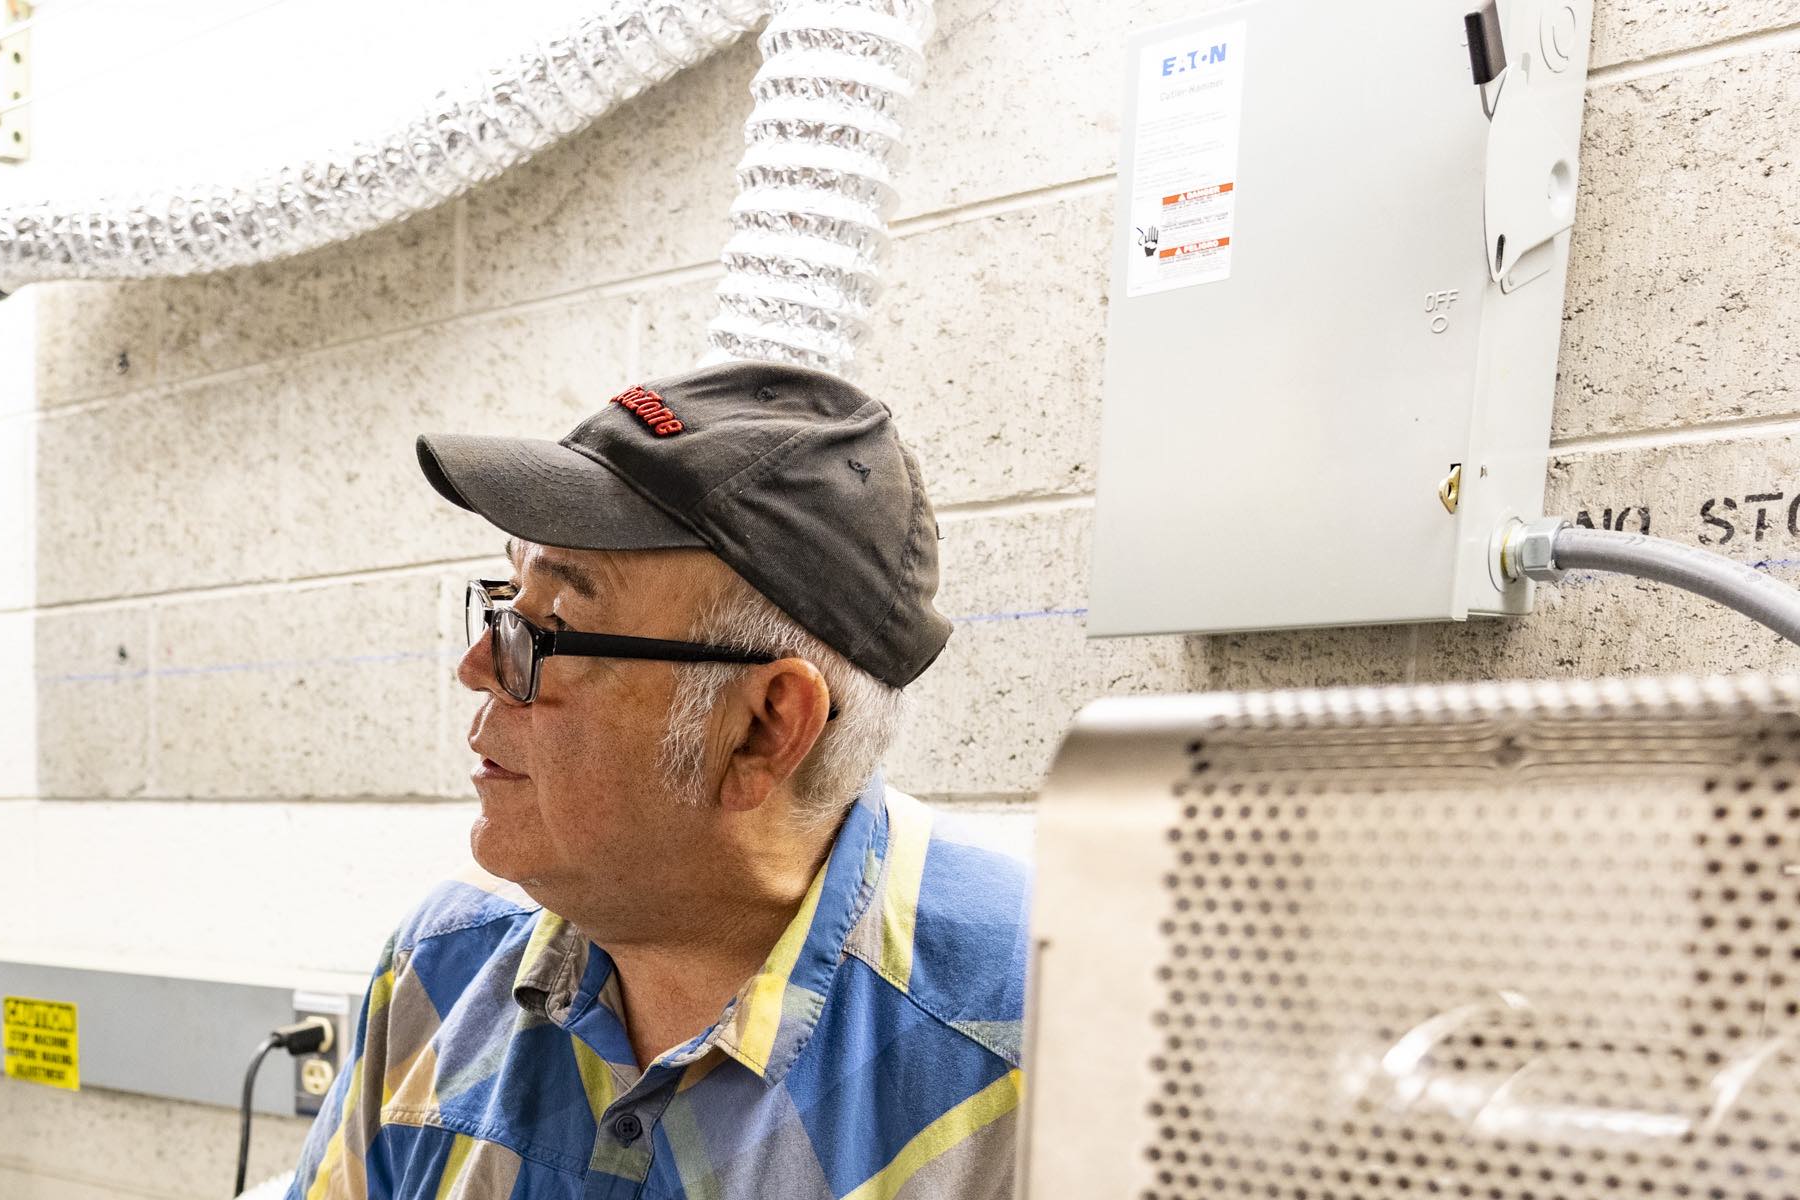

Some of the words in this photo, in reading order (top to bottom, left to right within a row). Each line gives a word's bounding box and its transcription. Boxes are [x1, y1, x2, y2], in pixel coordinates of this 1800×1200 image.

[1186, 184, 1220, 201] DANGER
[1182, 238, 1219, 255] PELIGRO
[1424, 289, 1459, 313] OFF
[6, 1001, 74, 1030] CAUTION
